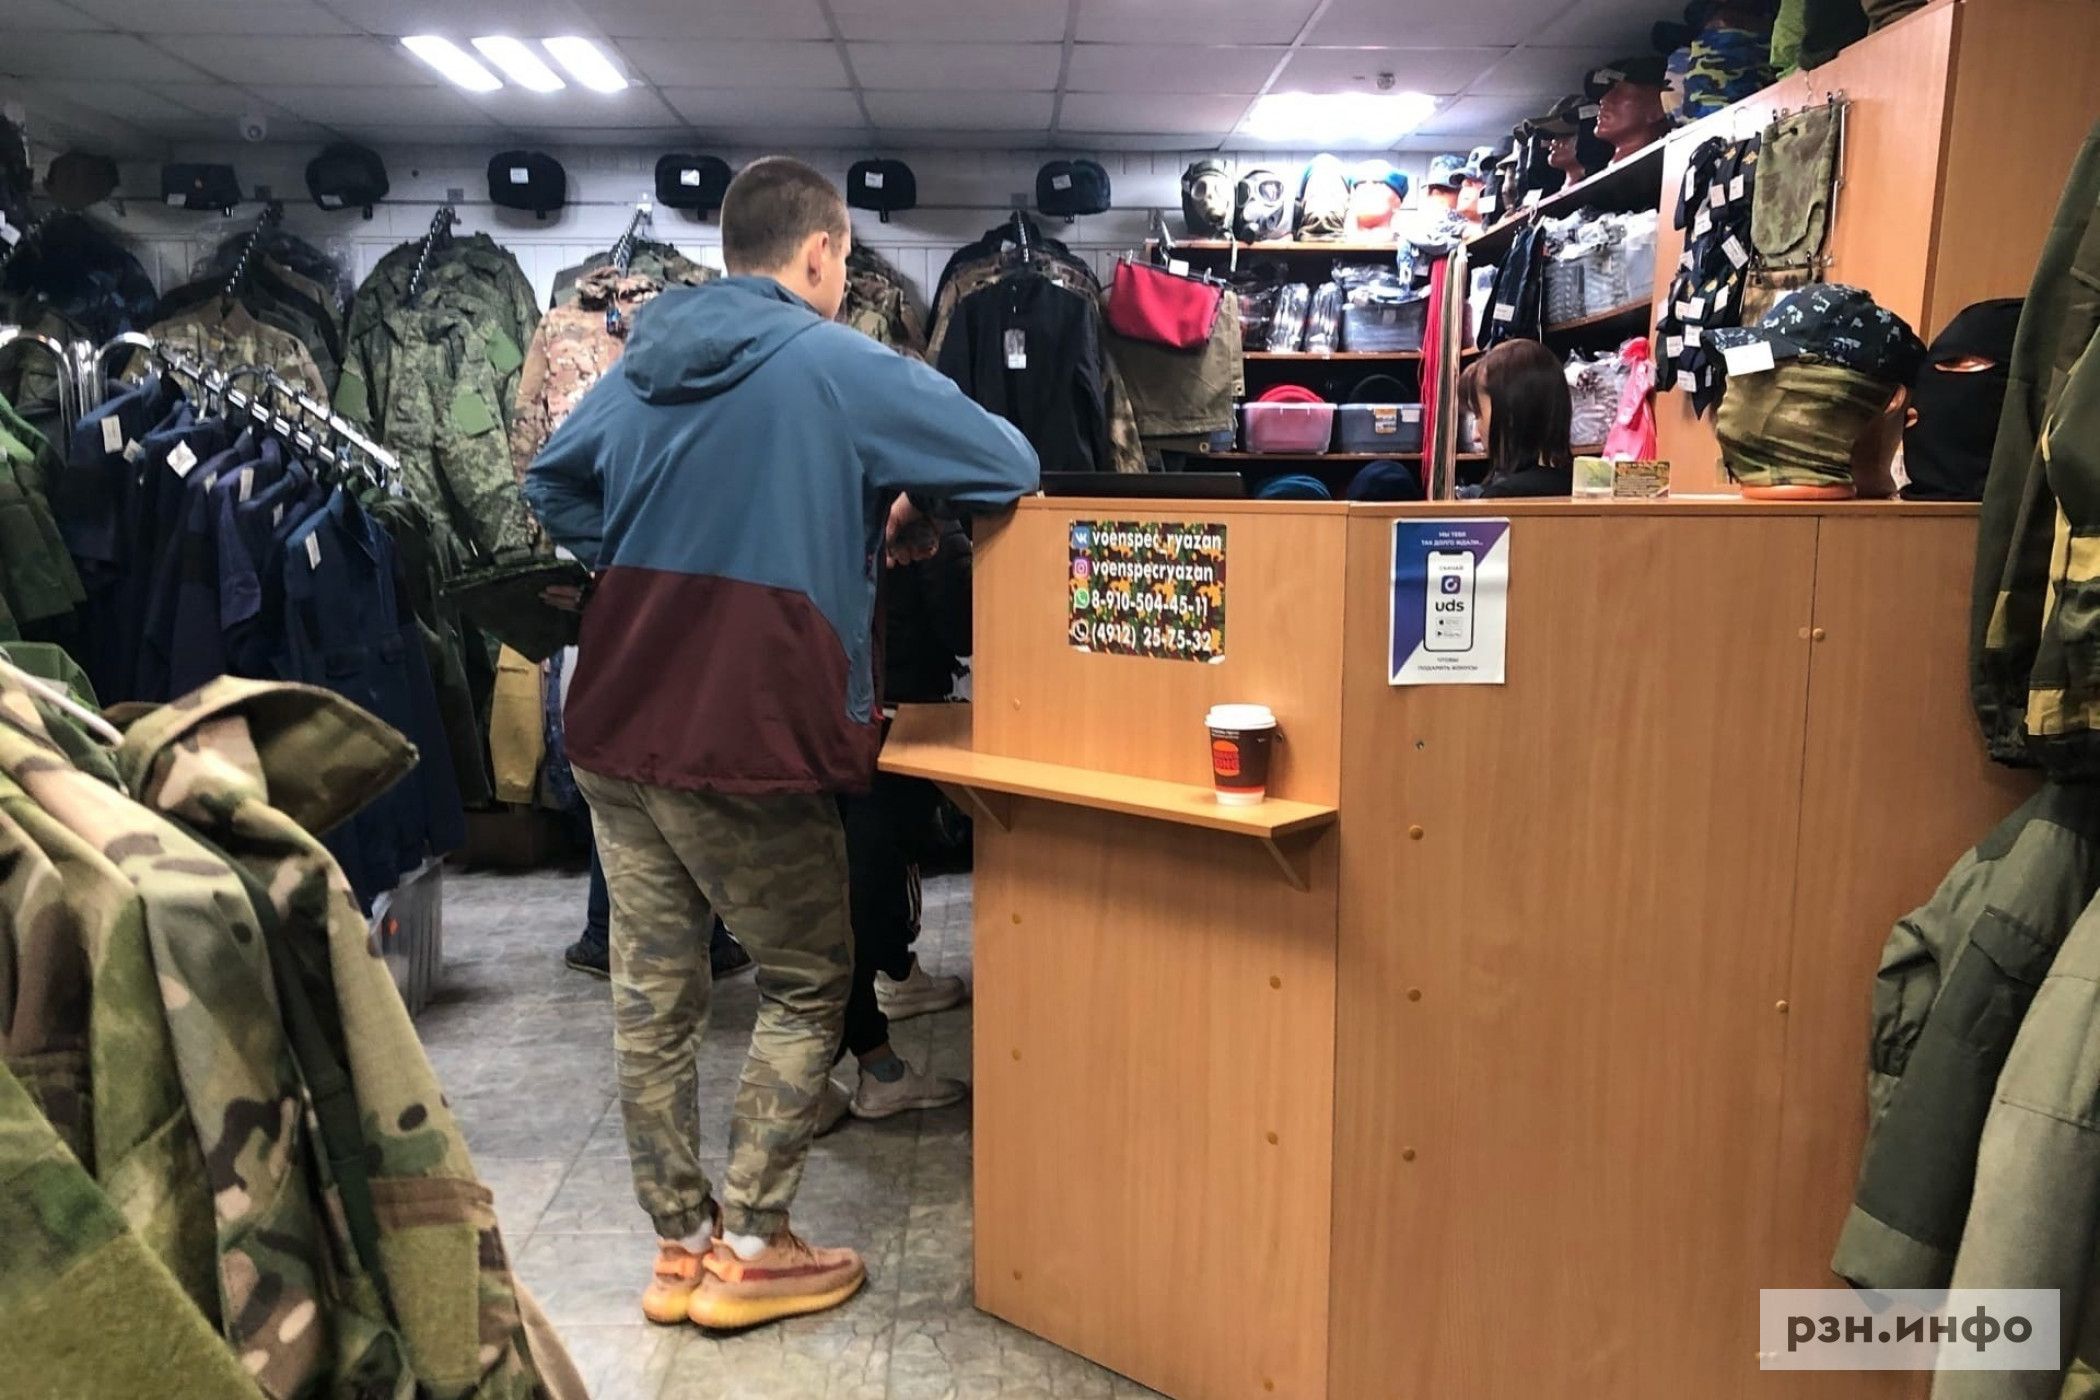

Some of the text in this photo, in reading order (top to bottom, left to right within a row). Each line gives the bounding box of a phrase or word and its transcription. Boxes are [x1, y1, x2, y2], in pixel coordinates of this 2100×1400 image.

[1092, 530, 1222, 555] voenspec_ryazan
[1092, 561, 1213, 584] voenspecryazan
[1091, 591, 1208, 617] 8-910-504-45-11
[1435, 599, 1465, 612] uds
[1092, 622, 1137, 649] (4912)
